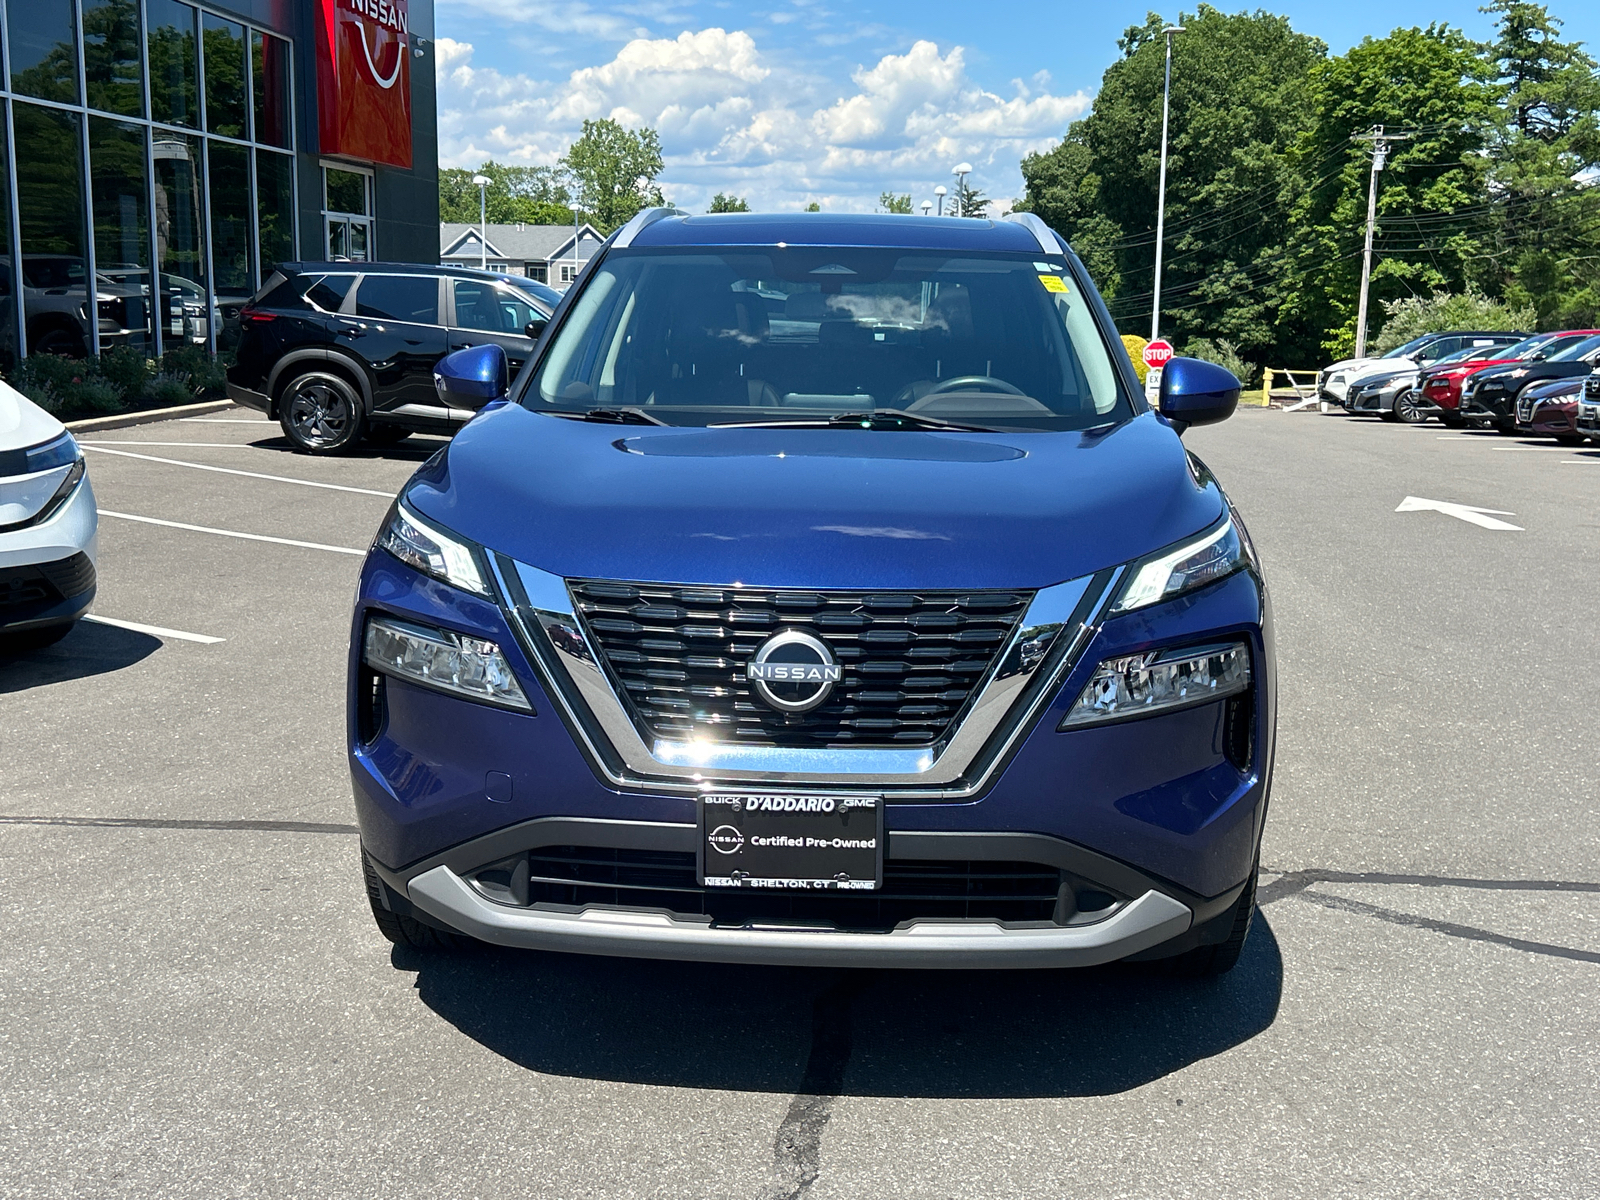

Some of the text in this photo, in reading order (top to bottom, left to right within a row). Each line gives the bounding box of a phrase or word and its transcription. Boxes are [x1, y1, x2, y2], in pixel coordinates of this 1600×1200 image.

[351, 0, 407, 34] NISSAN
[1145, 349, 1171, 360] STOP
[1149, 375, 1159, 383] EX
[750, 665, 839, 679] NISSAN
[704, 796, 876, 812] BUICK D'ADDARIO GMC
[708, 835, 745, 843] NISSAN
[750, 835, 876, 849] Certified Pre-Owned
[704, 878, 875, 890] NISSAN SHELTON, CT PRE-OWNED
